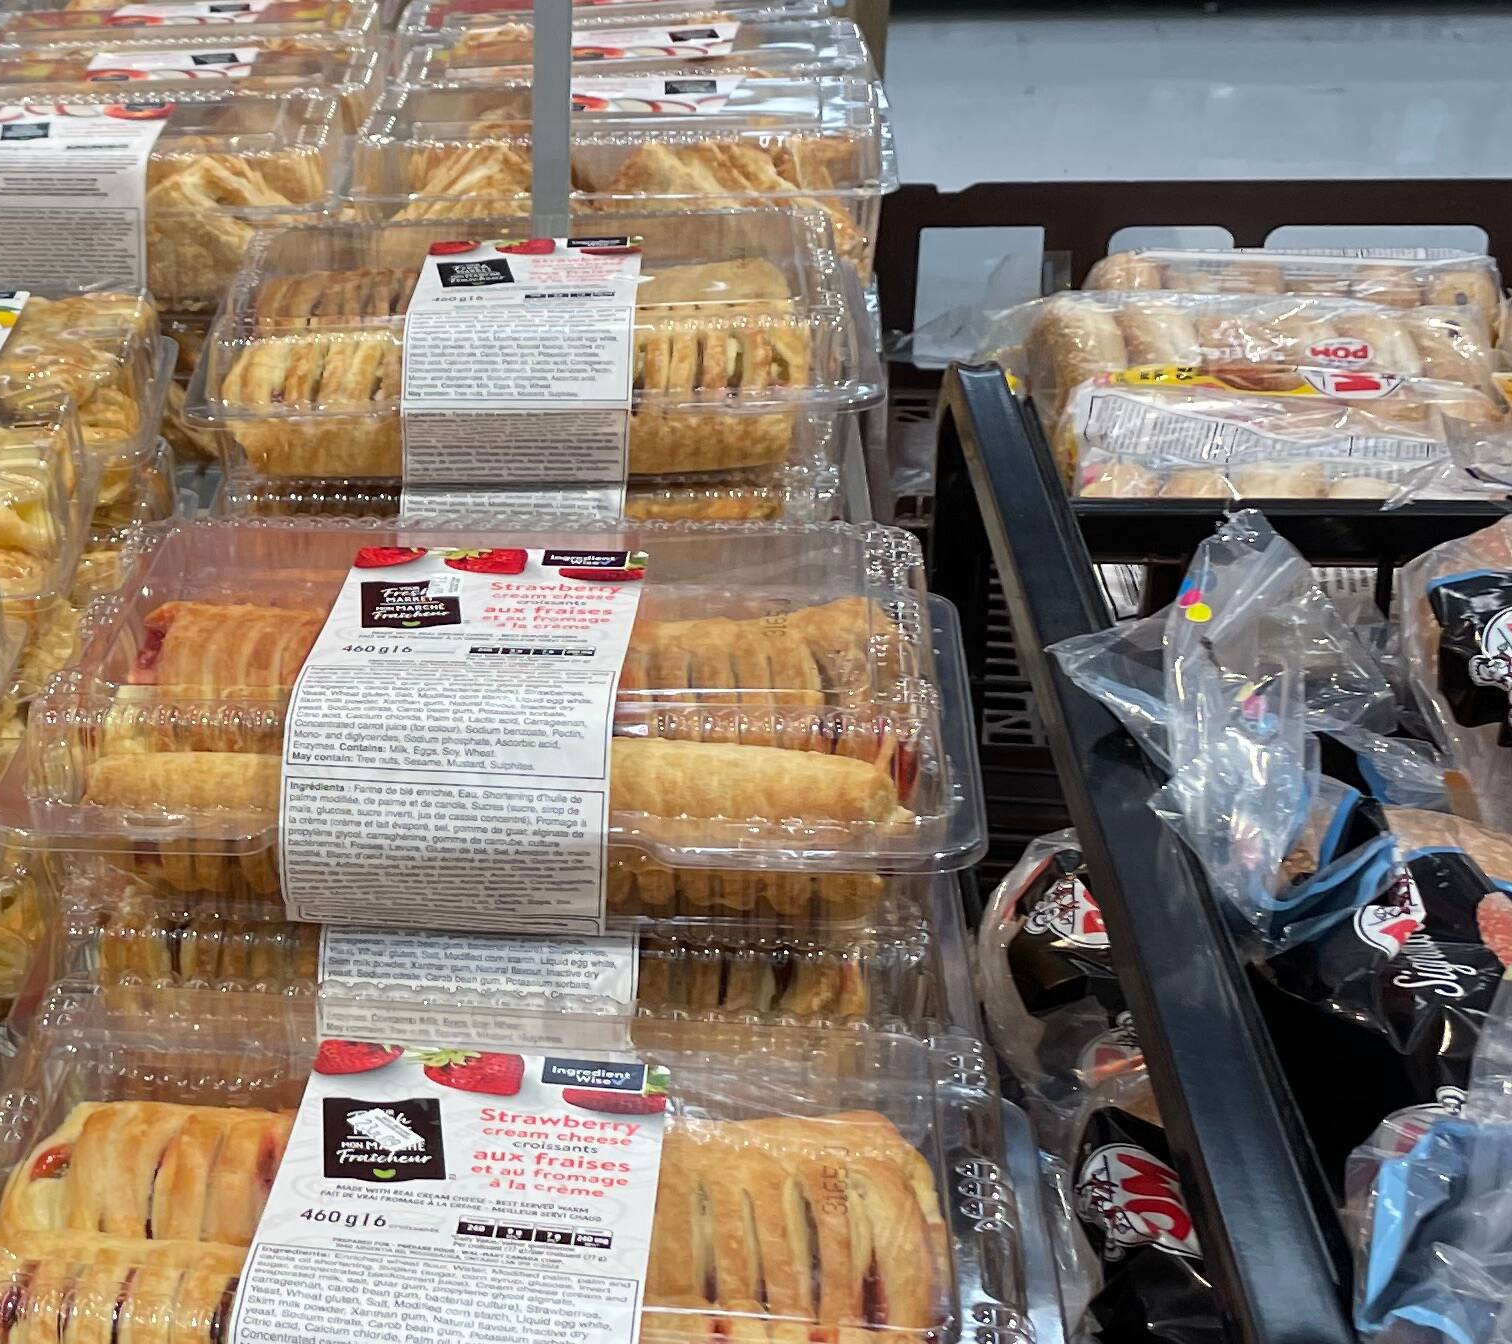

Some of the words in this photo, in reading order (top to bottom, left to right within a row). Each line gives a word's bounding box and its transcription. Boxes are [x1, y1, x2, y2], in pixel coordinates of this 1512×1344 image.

[490, 582, 622, 594] Strawberry
[483, 606, 526, 615] aux
[534, 606, 612, 616] fraises
[552, 1065, 631, 1080] Ingredient
[480, 1108, 640, 1136] Strawberry
[482, 1126, 549, 1141] cream
[556, 1132, 633, 1147] cheese
[512, 1140, 598, 1154] croissants
[473, 1149, 524, 1164] aux
[536, 1152, 631, 1173] fraises
[471, 1164, 491, 1175] et
[500, 1166, 525, 1178] au
[534, 1167, 629, 1187] fromage
[508, 1179, 527, 1191] la
[534, 1181, 604, 1197] crème
[300, 1209, 341, 1222] 460
[374, 1215, 386, 1227] 6
